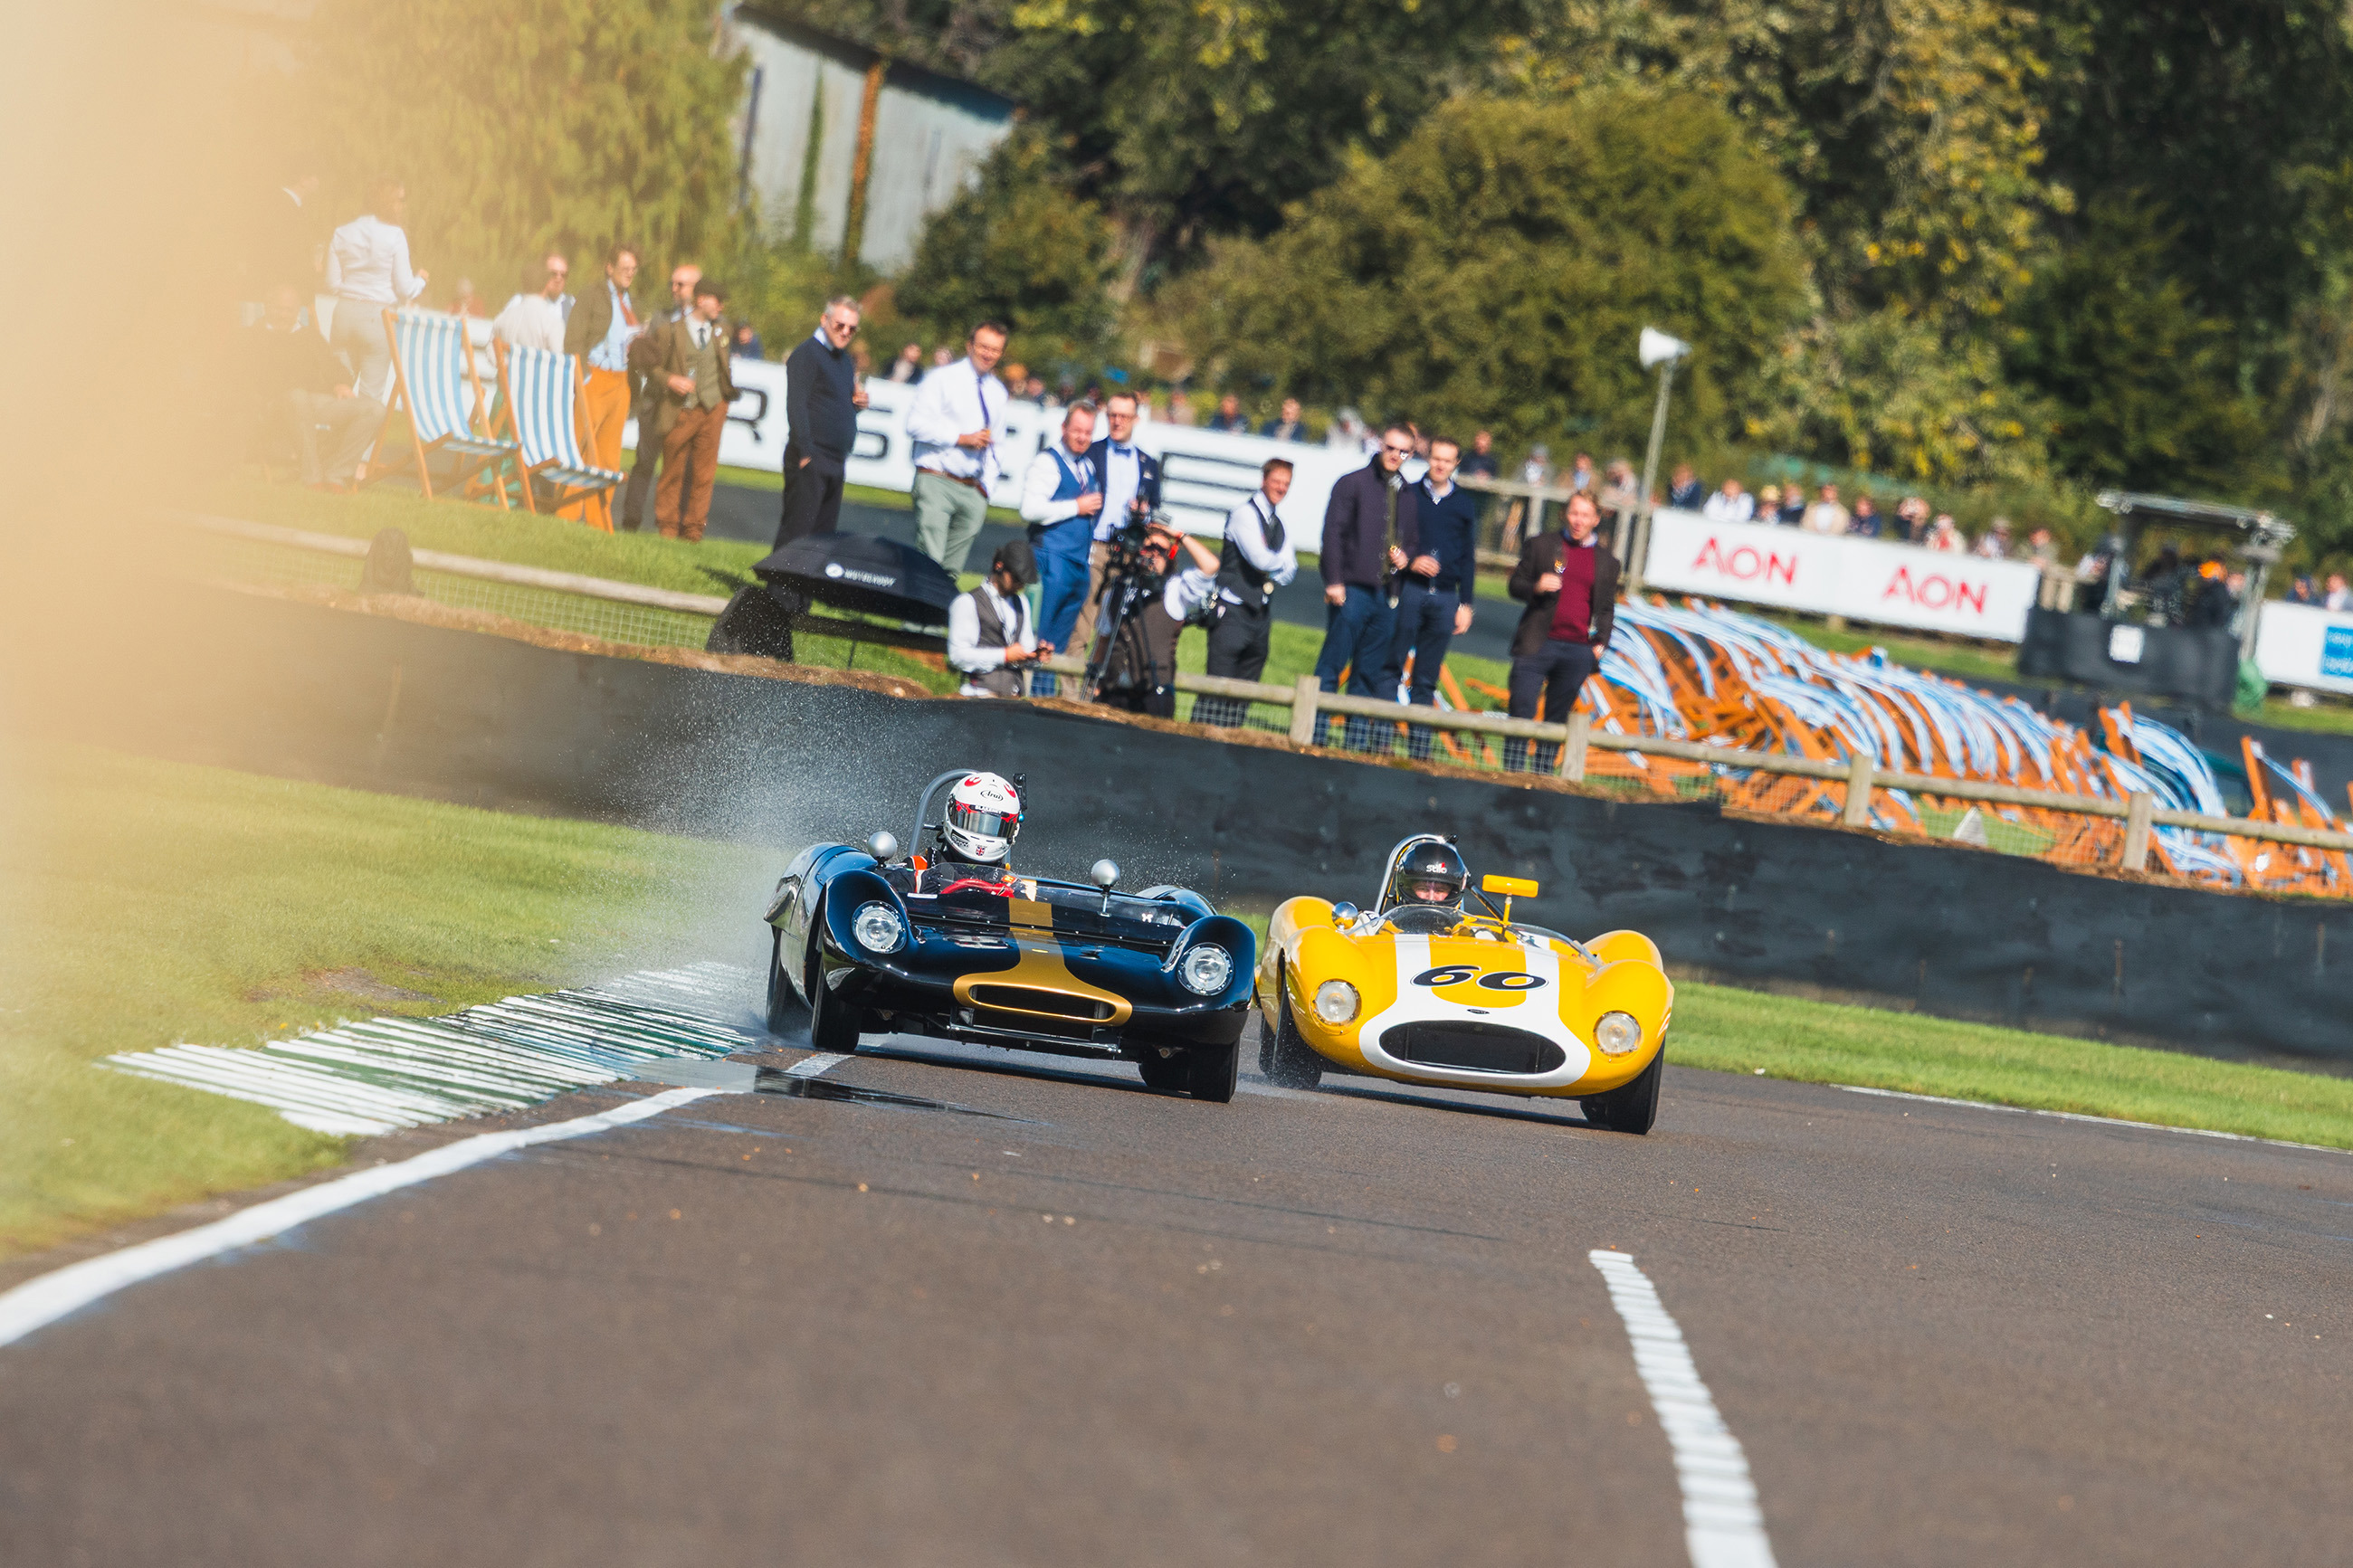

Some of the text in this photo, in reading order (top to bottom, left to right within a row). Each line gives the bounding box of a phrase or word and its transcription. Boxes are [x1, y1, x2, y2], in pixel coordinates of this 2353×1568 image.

[1692, 537, 1796, 585] AON
[1882, 565, 1987, 613] AON
[1411, 965, 1548, 991] 60
